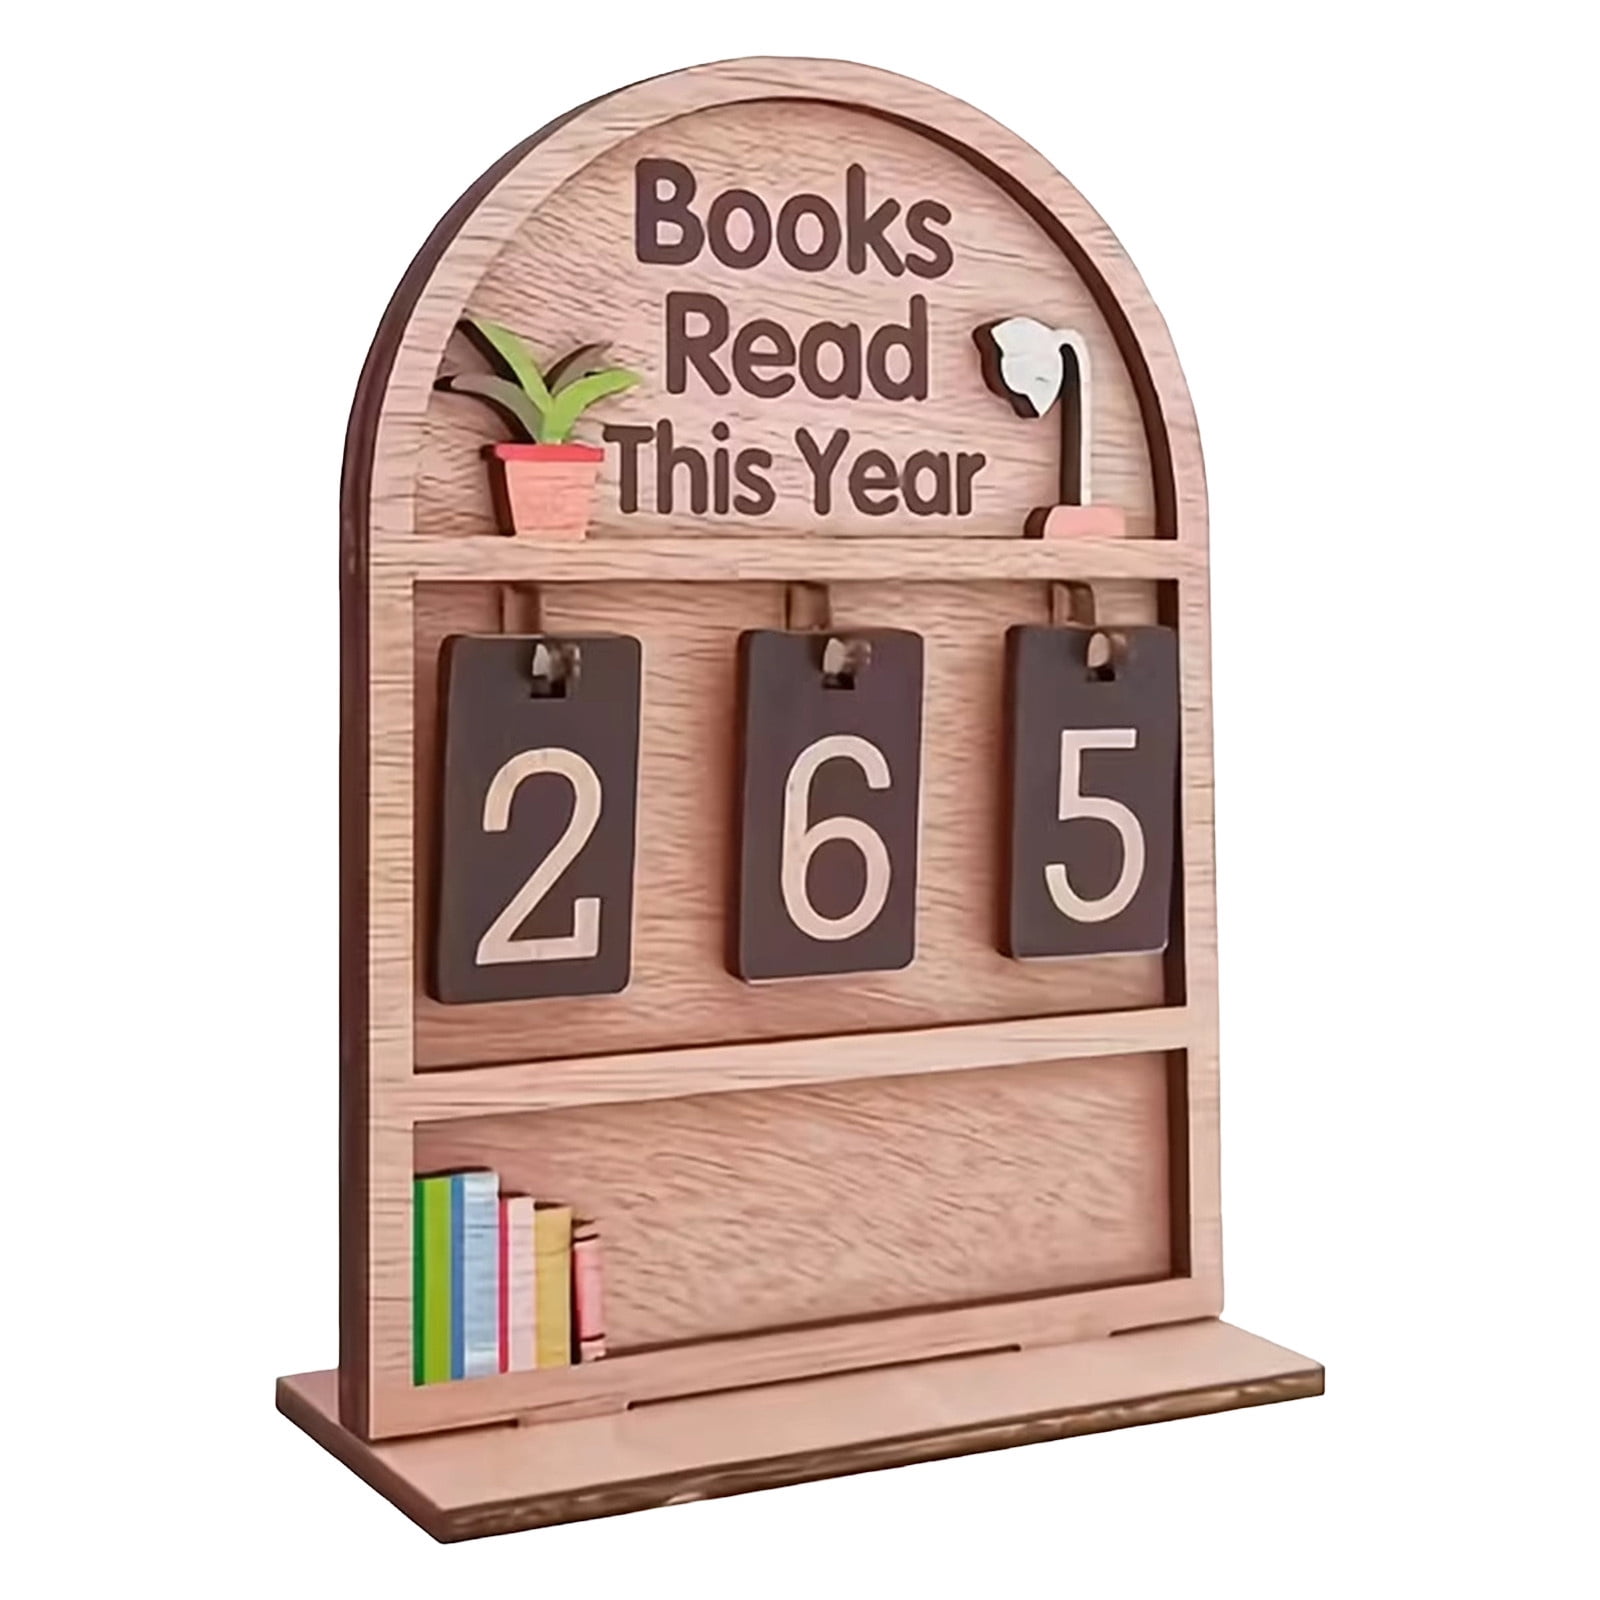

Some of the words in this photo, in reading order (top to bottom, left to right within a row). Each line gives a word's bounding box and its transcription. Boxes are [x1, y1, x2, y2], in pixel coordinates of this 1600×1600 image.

[634, 157, 954, 279] Books
[665, 291, 928, 402] Read
[603, 420, 776, 516] This
[795, 427, 986, 516] Year
[475, 747, 602, 965] 2
[780, 733, 891, 941] 6
[1044, 728, 1145, 923] 5
